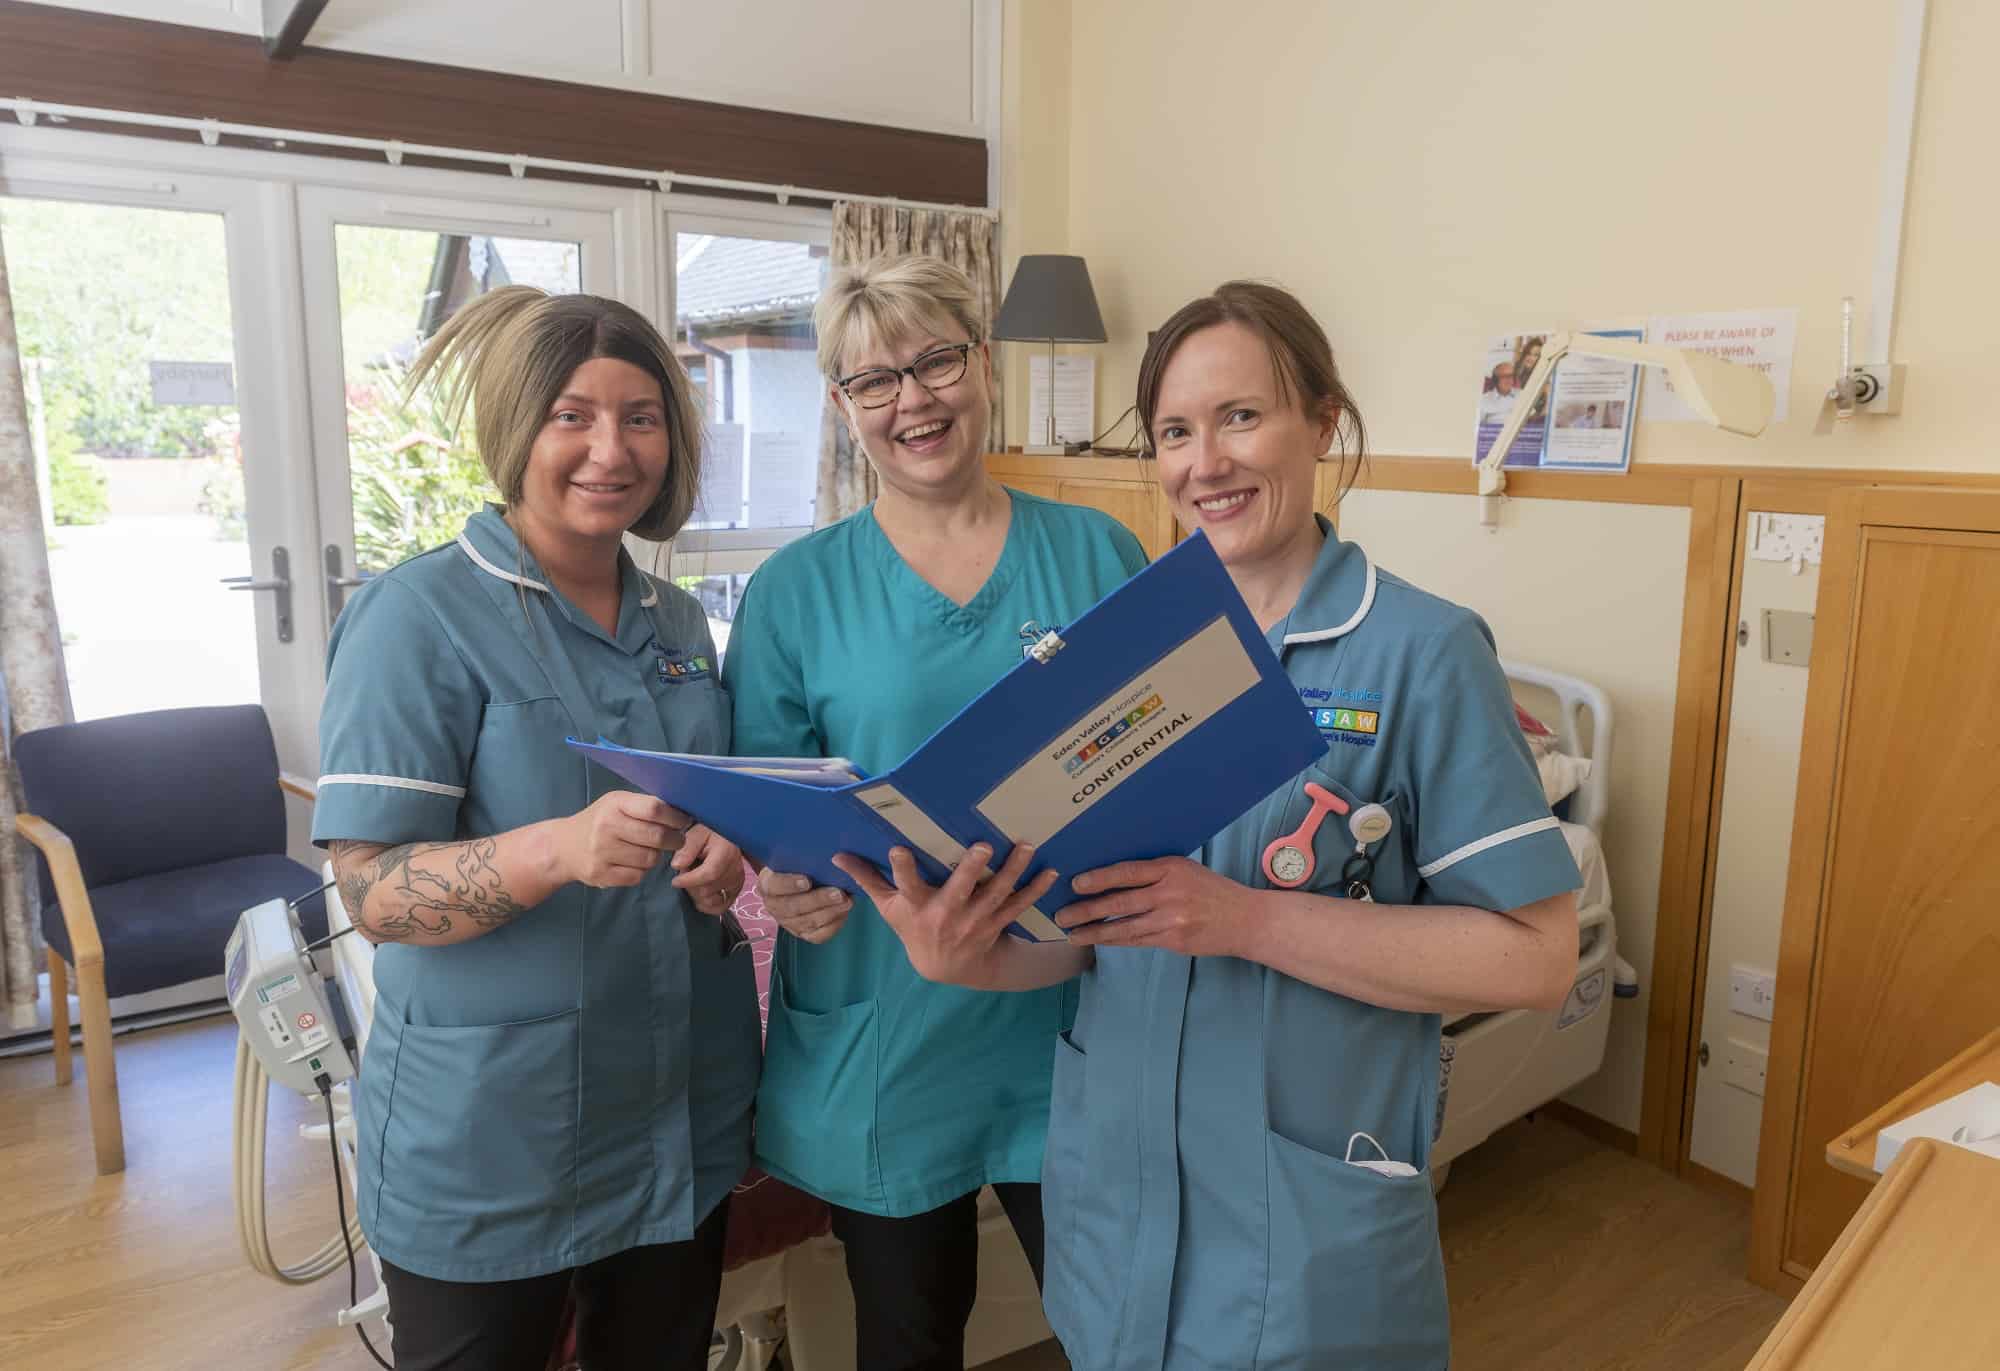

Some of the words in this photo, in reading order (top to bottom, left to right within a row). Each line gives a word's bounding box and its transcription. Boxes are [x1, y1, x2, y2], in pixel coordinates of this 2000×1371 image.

[1664, 329, 1699, 342] PLEASE
[1703, 329, 1717, 341] BE
[1719, 327, 1758, 339] AWARE
[1761, 326, 1776, 338] OF
[1721, 344, 1756, 357] WHEN
[1300, 687, 1332, 701] Valley
[1052, 735, 1081, 761] Eden
[1079, 713, 1112, 739] Valley
[1111, 683, 1152, 716] Hospice
[1066, 694, 1161, 770] JIGSAW
[1071, 712, 1192, 804] CONFIDENTIAL
